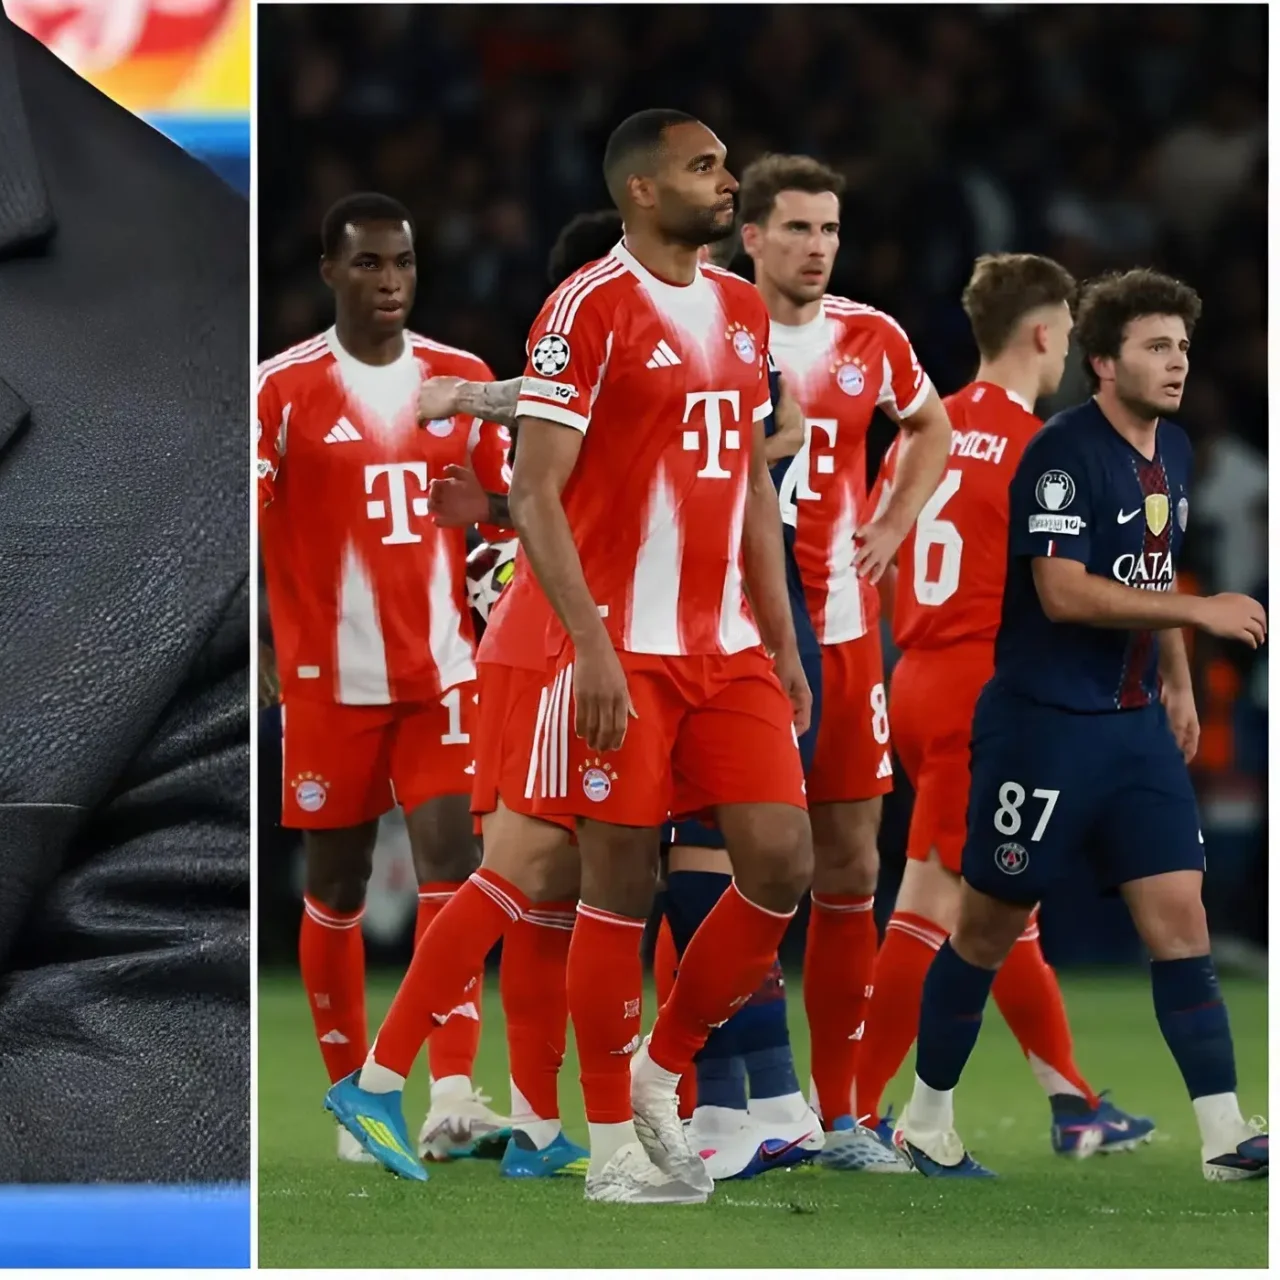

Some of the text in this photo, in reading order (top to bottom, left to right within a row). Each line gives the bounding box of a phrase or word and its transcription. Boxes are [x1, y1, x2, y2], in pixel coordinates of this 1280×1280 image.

[683, 390, 740, 479] T
[363, 462, 429, 545] T
[913, 469, 964, 607] 6
[440, 688, 479, 746] 1
[869, 683, 890, 745] 8
[993, 781, 1061, 842] 87
